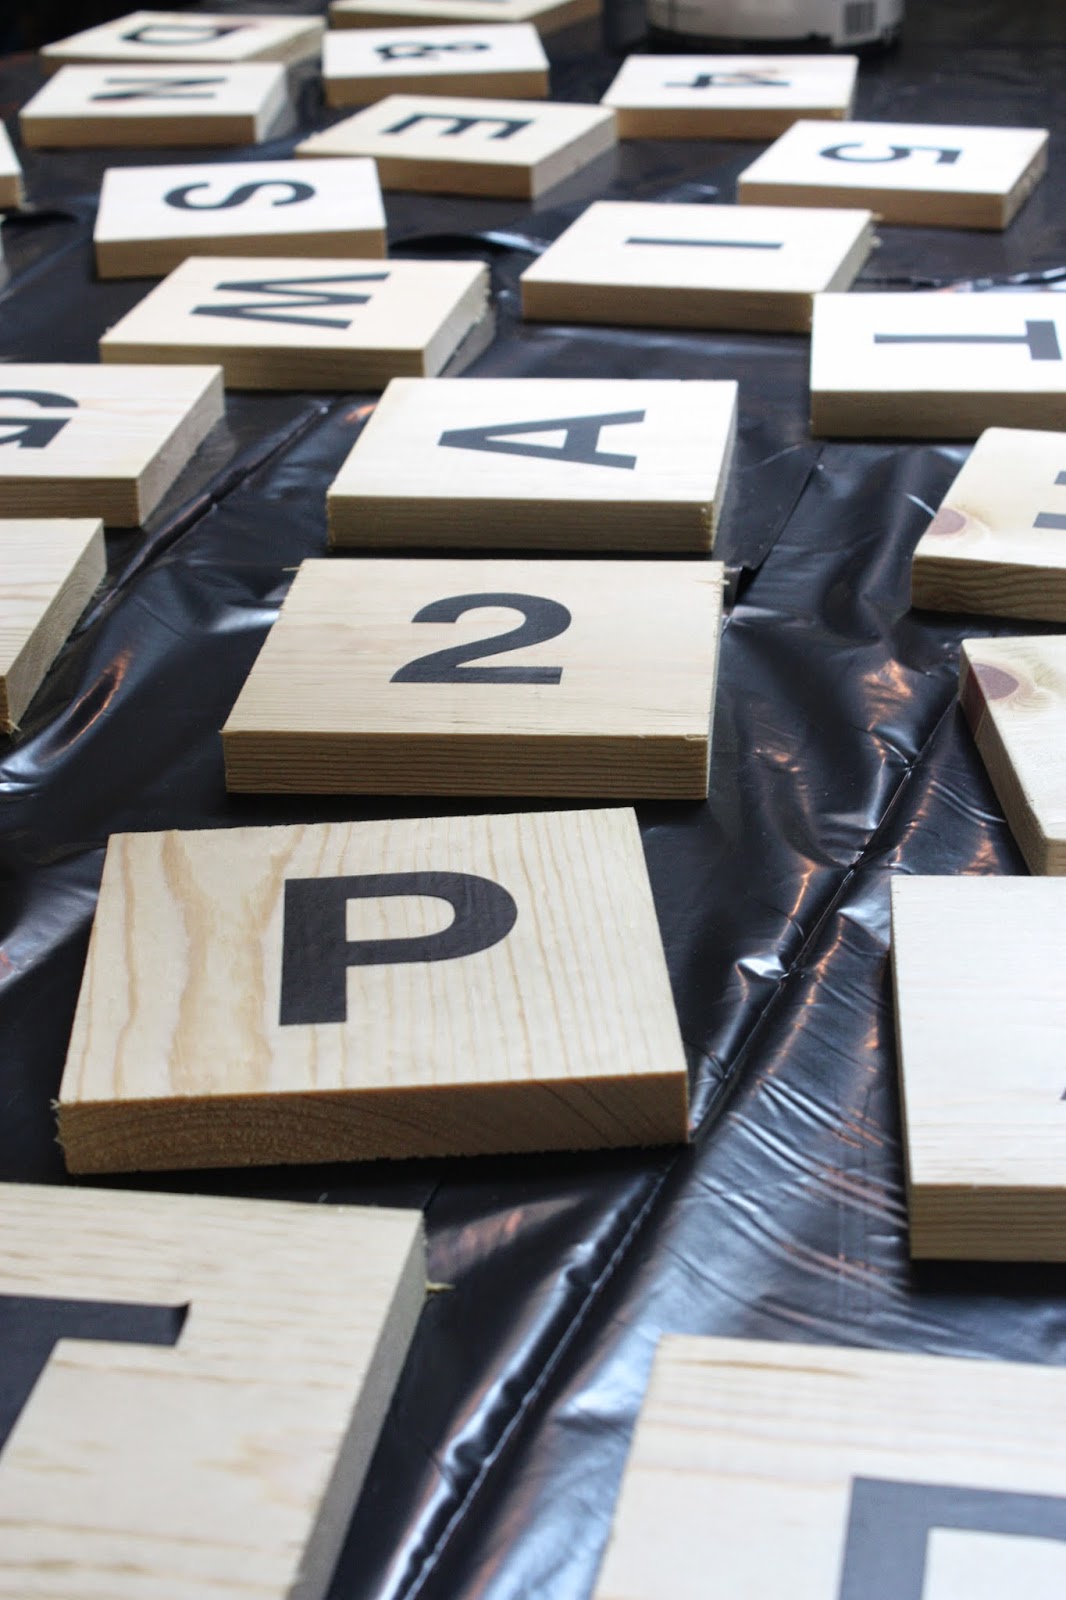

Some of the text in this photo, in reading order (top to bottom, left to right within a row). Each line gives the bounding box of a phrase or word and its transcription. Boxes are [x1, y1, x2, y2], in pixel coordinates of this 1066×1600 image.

[381, 112, 535, 141] E
[819, 141, 962, 165] 5
[163, 178, 317, 211] S
[873, 319, 1063, 361] T
[437, 409, 646, 471] A
[388, 592, 573, 686] 2
[278, 870, 519, 1027] P
